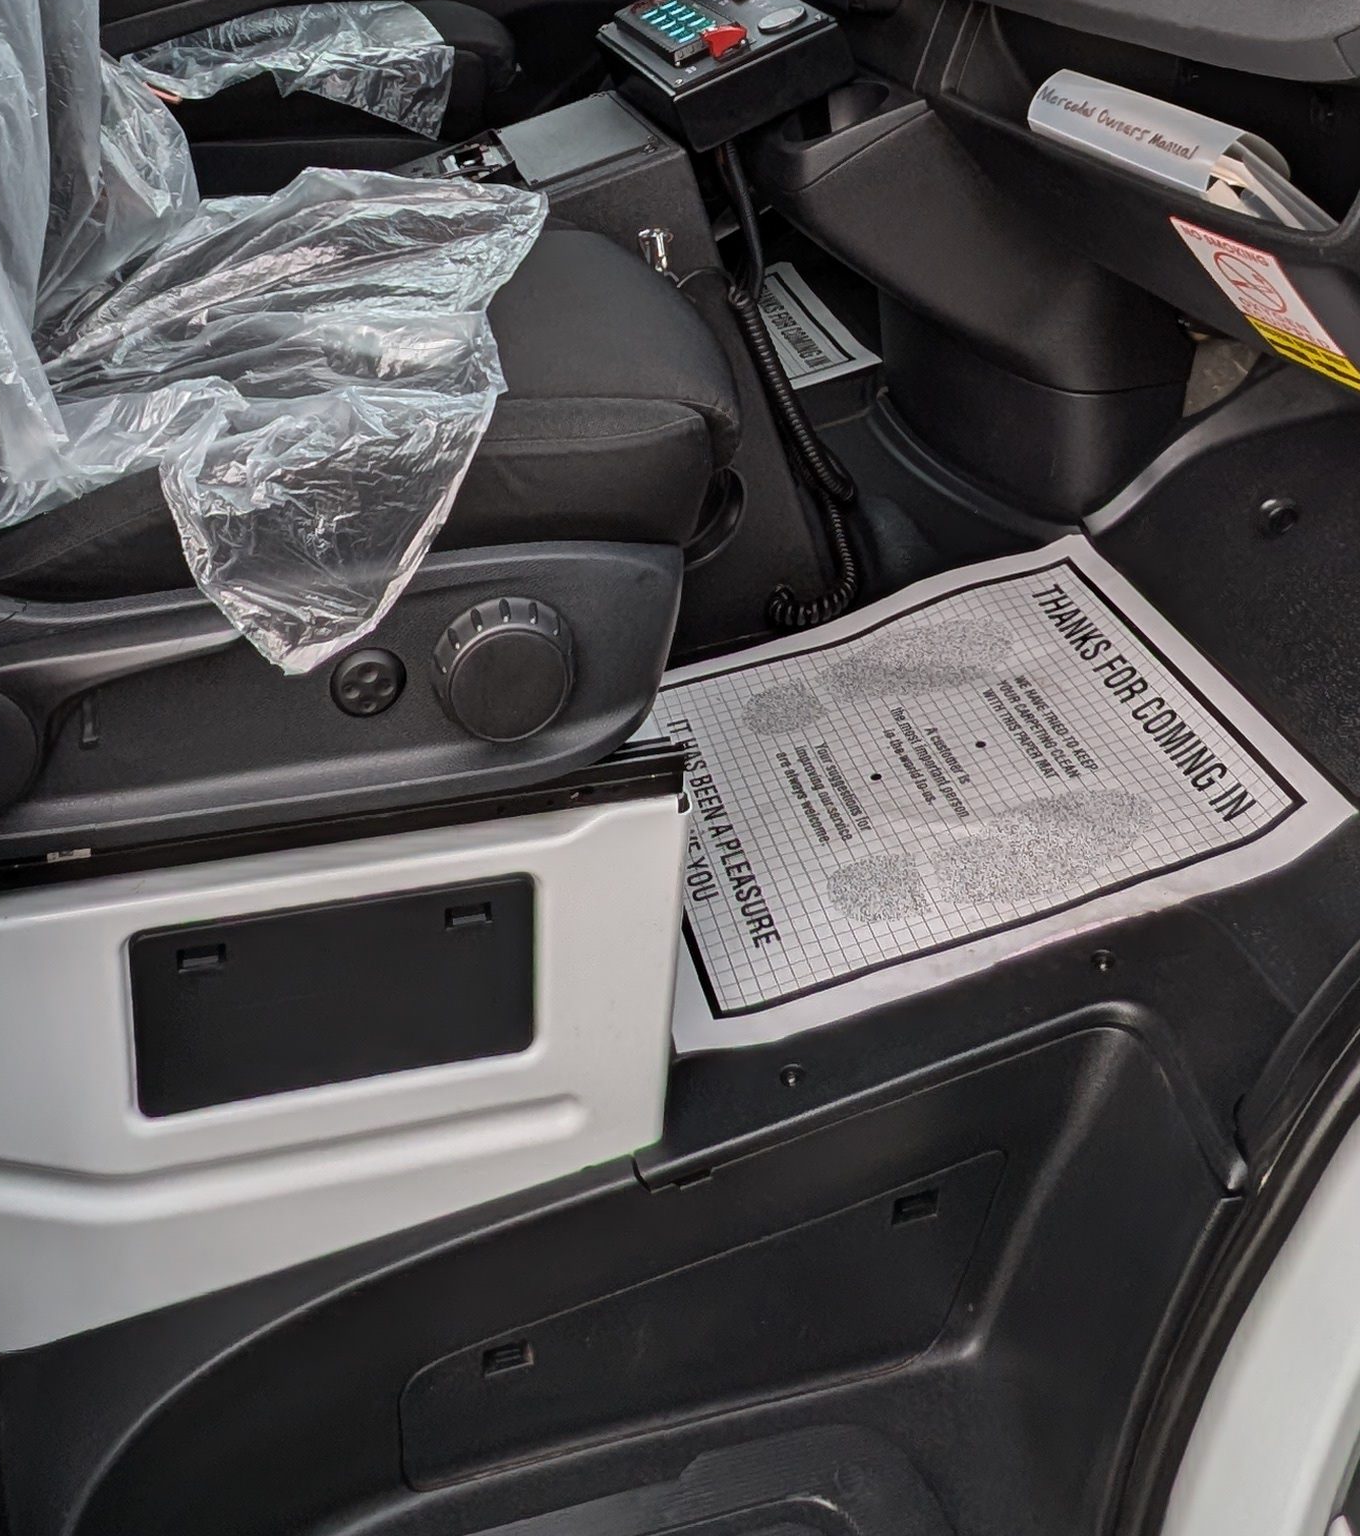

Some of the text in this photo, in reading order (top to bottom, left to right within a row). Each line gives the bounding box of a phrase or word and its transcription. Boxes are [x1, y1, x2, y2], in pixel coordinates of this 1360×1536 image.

[1148, 133, 1200, 160] Manual
[1180, 225, 1269, 267] NO SMOKING
[781, 327, 822, 359] COMING
[667, 718, 692, 733] IT
[997, 679, 1080, 778] YOUR CARPETING CLEAN
[1015, 675, 1098, 770] WE HAVE TRIED TO KEEP
[1032, 583, 1257, 822] THANKS FOR COMING IN
[674, 737, 707, 772] HAS
[924, 727, 971, 784] A customer is
[983, 688, 1060, 779] WITH THIS PAPER MAT
[776, 751, 791, 768] are
[784, 769, 807, 800] always
[814, 742, 872, 831] Your suggestions for
[890, 739, 904, 755] the
[900, 755, 924, 779] world
[915, 777, 928, 791] to
[891, 707, 970, 818] the most important person
[689, 774, 728, 821] BEEN
[795, 745, 853, 842] improving our service
[708, 823, 734, 838] A
[687, 856, 719, 902] YOU
[715, 837, 781, 949] PLEASURE
